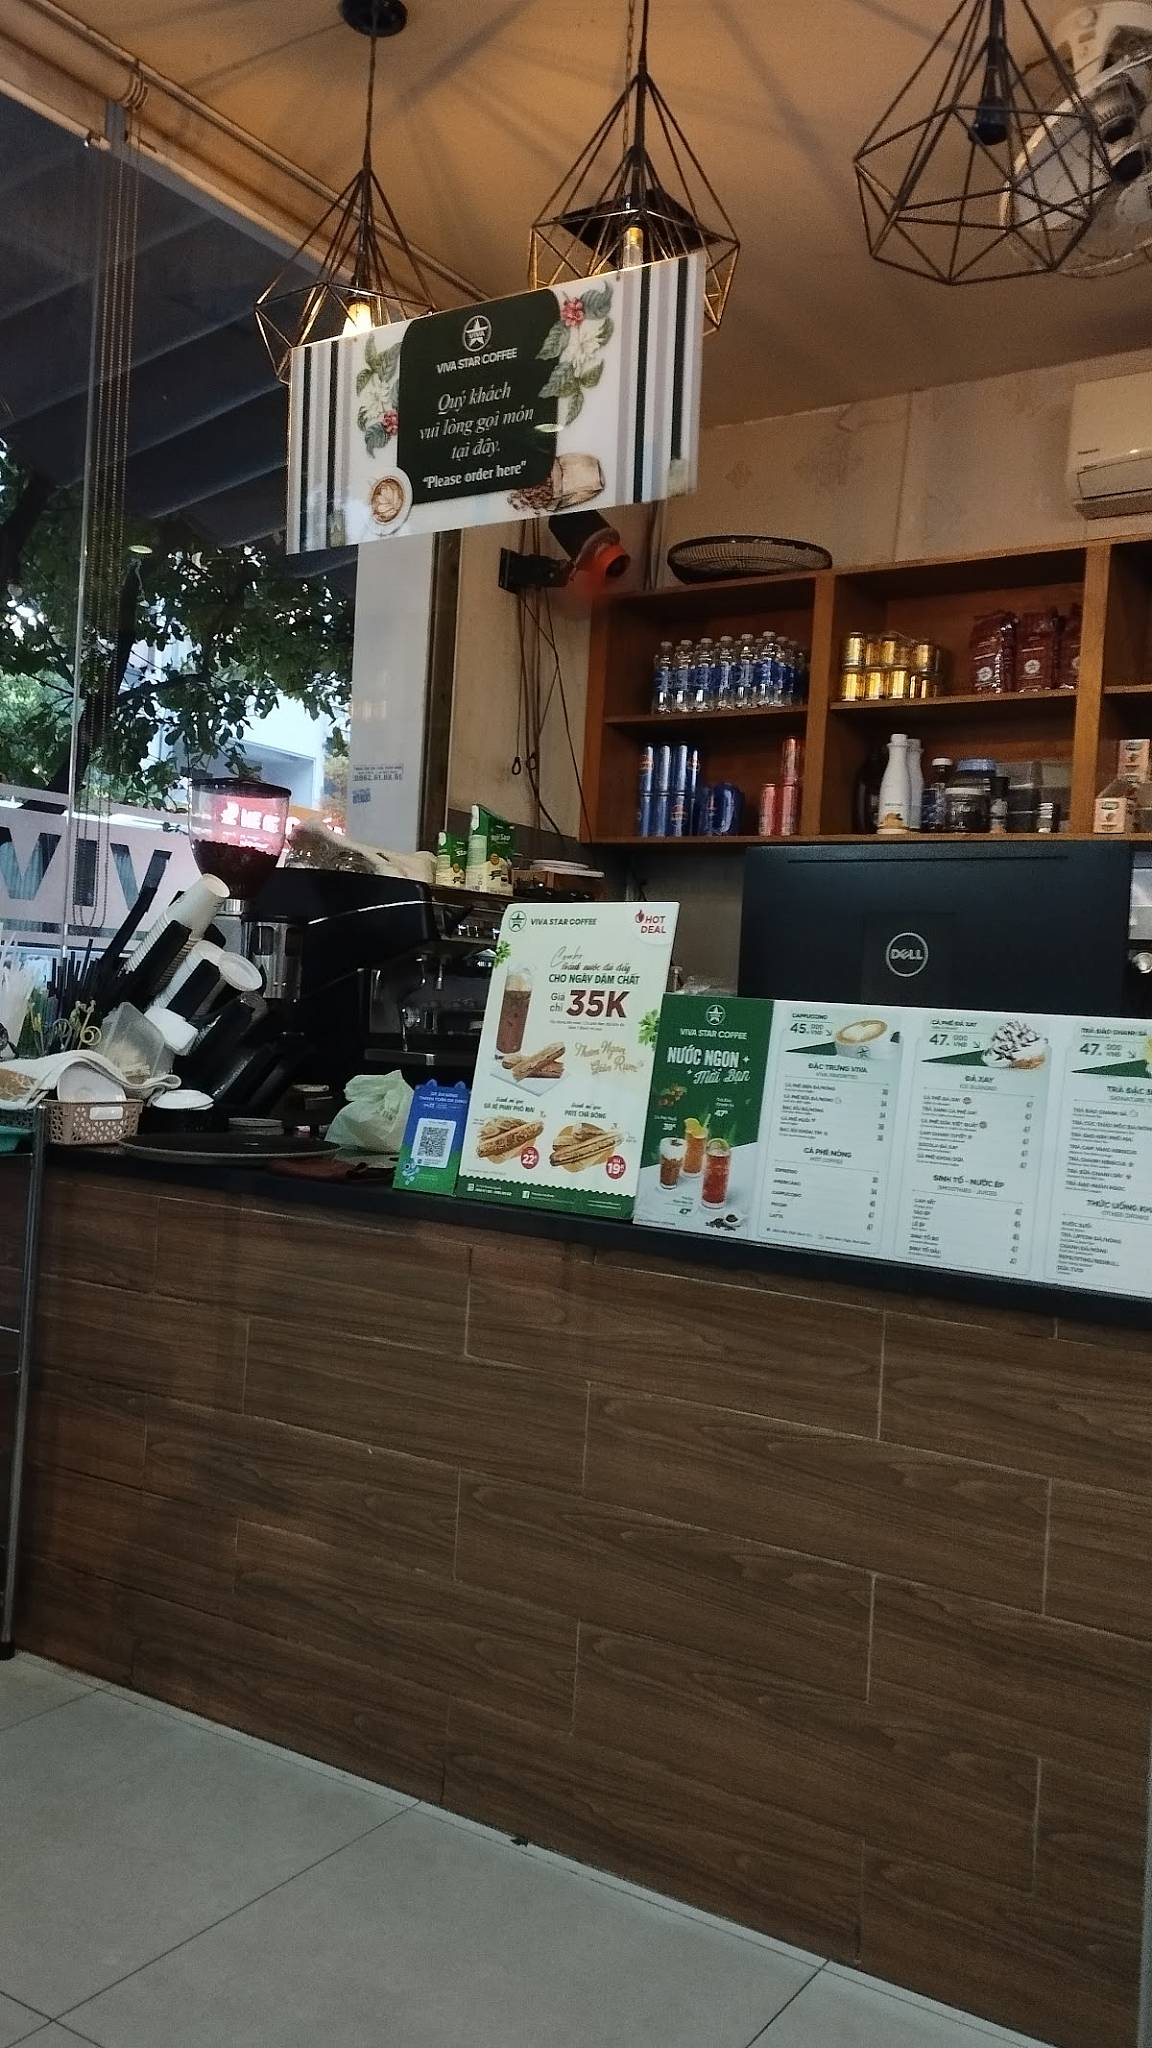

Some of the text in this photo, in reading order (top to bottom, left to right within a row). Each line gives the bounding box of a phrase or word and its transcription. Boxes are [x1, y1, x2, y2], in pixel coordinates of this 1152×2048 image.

[436, 347, 518, 374] VIVA STAR COFFEE
[437, 381, 512, 415] Quý khách
[420, 404, 534, 440] vui lòng gọi món
[450, 442, 471, 461] tại
[464, 467, 494, 483] order
[530, 917, 598, 926] VIVA STAR COFFEE
[645, 915, 666, 924] HOT
[640, 925, 667, 934] DEAL
[890, 948, 923, 960] DELL
[549, 974, 567, 983] CHO
[566, 989, 631, 1018] 35K
[680, 1028, 748, 1040] VIVA STAR COFFEE
[667, 1044, 740, 1068] NƯỚC NGON
